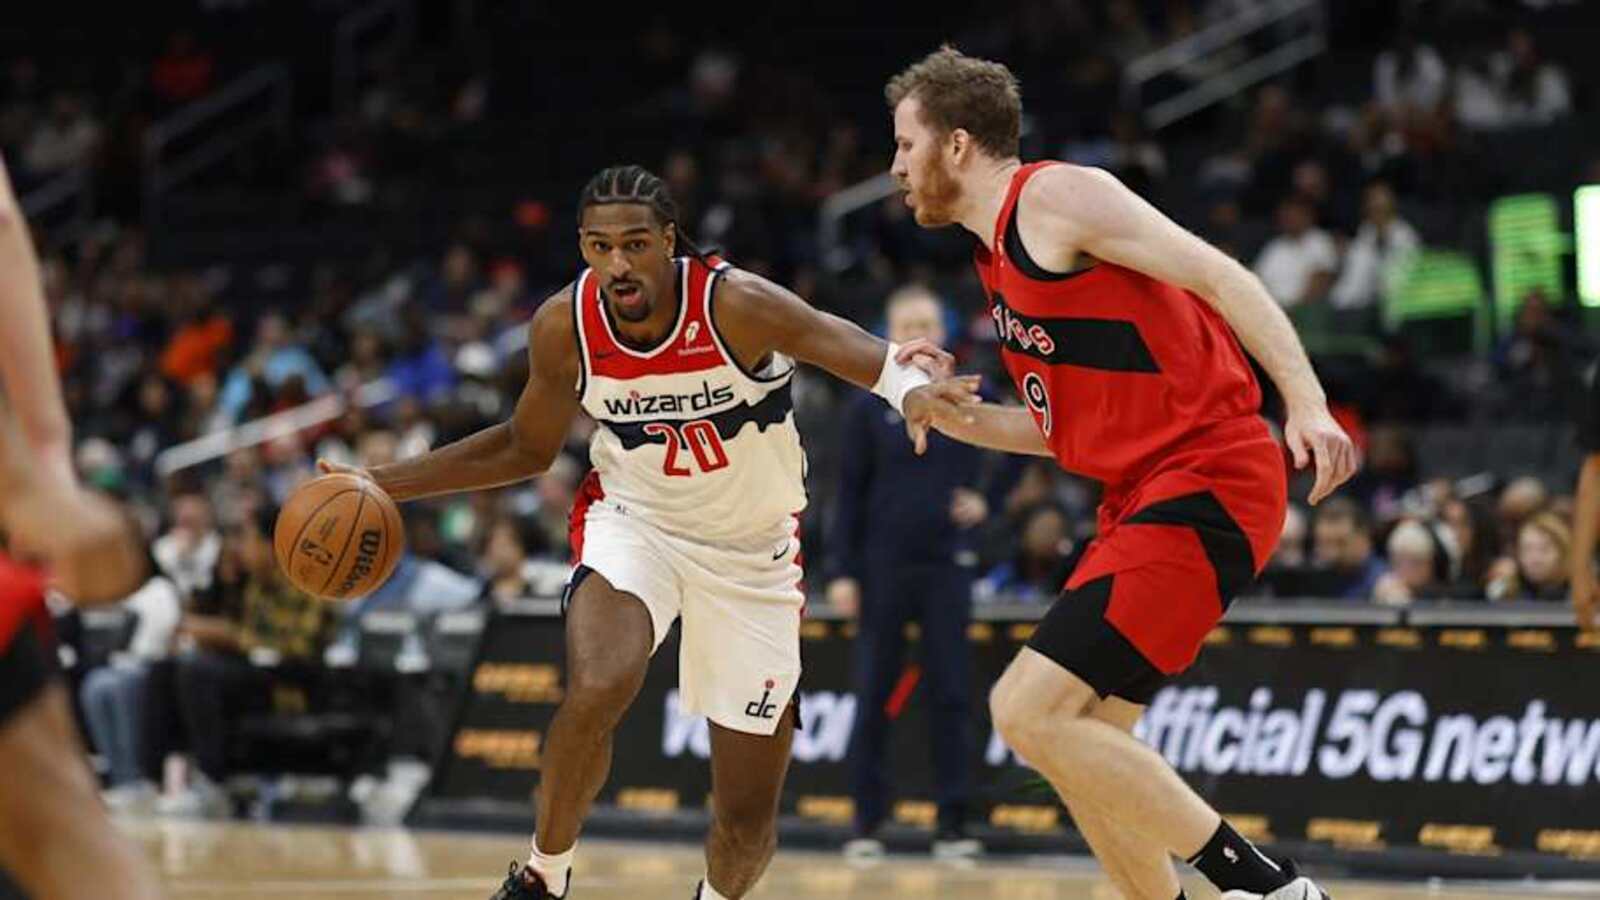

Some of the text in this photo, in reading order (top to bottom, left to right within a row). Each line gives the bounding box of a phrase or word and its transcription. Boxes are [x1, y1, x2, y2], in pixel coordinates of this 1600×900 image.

[603, 381, 735, 415] wizards
[644, 419, 730, 477] 20
[1132, 685, 1326, 776] fficial
[1318, 689, 1428, 781] 5G
